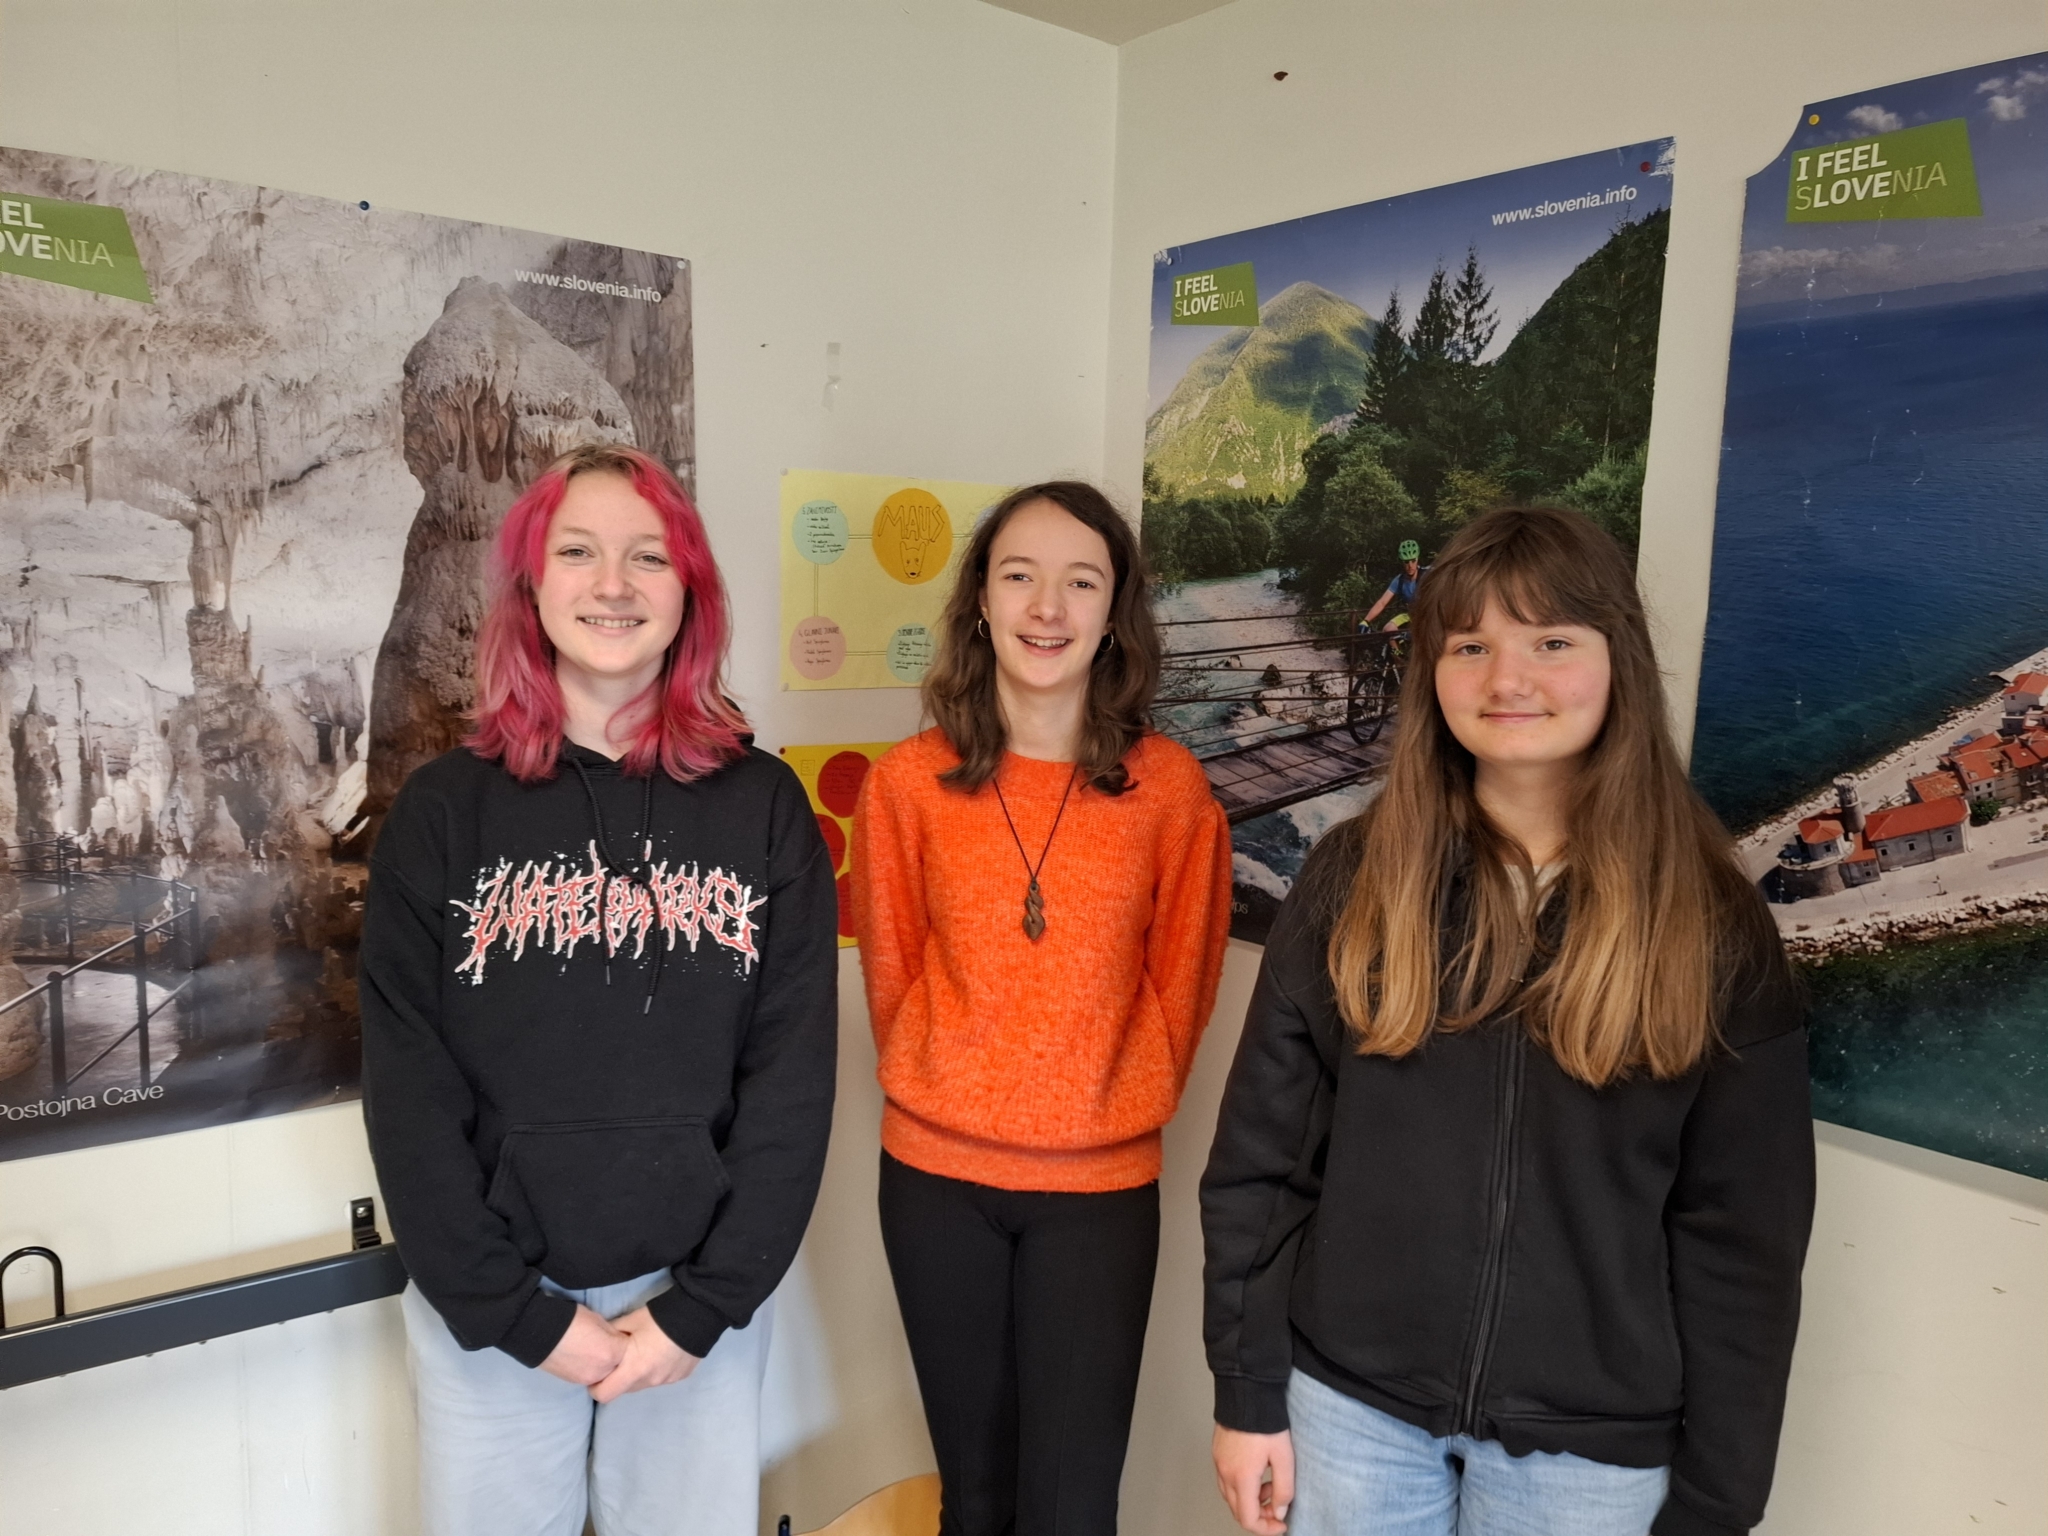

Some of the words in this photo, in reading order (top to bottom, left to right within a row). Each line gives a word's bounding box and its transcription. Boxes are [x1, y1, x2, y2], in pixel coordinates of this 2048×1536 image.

[1796, 157, 1810, 182] I
[1817, 143, 1888, 178] FEEL
[1795, 162, 1948, 210] SLOVENIA
[0, 199, 44, 229] EL
[1492, 185, 1638, 226] www.slovenia.info
[0, 230, 115, 268] VENIA
[514, 269, 662, 303] www.slovenia.info
[1174, 289, 1245, 317] SLOVENIA
[1175, 280, 1182, 298] I
[1184, 274, 1218, 296] FEEL
[878, 505, 945, 542] MAUS
[103, 1084, 165, 1107] Cave
